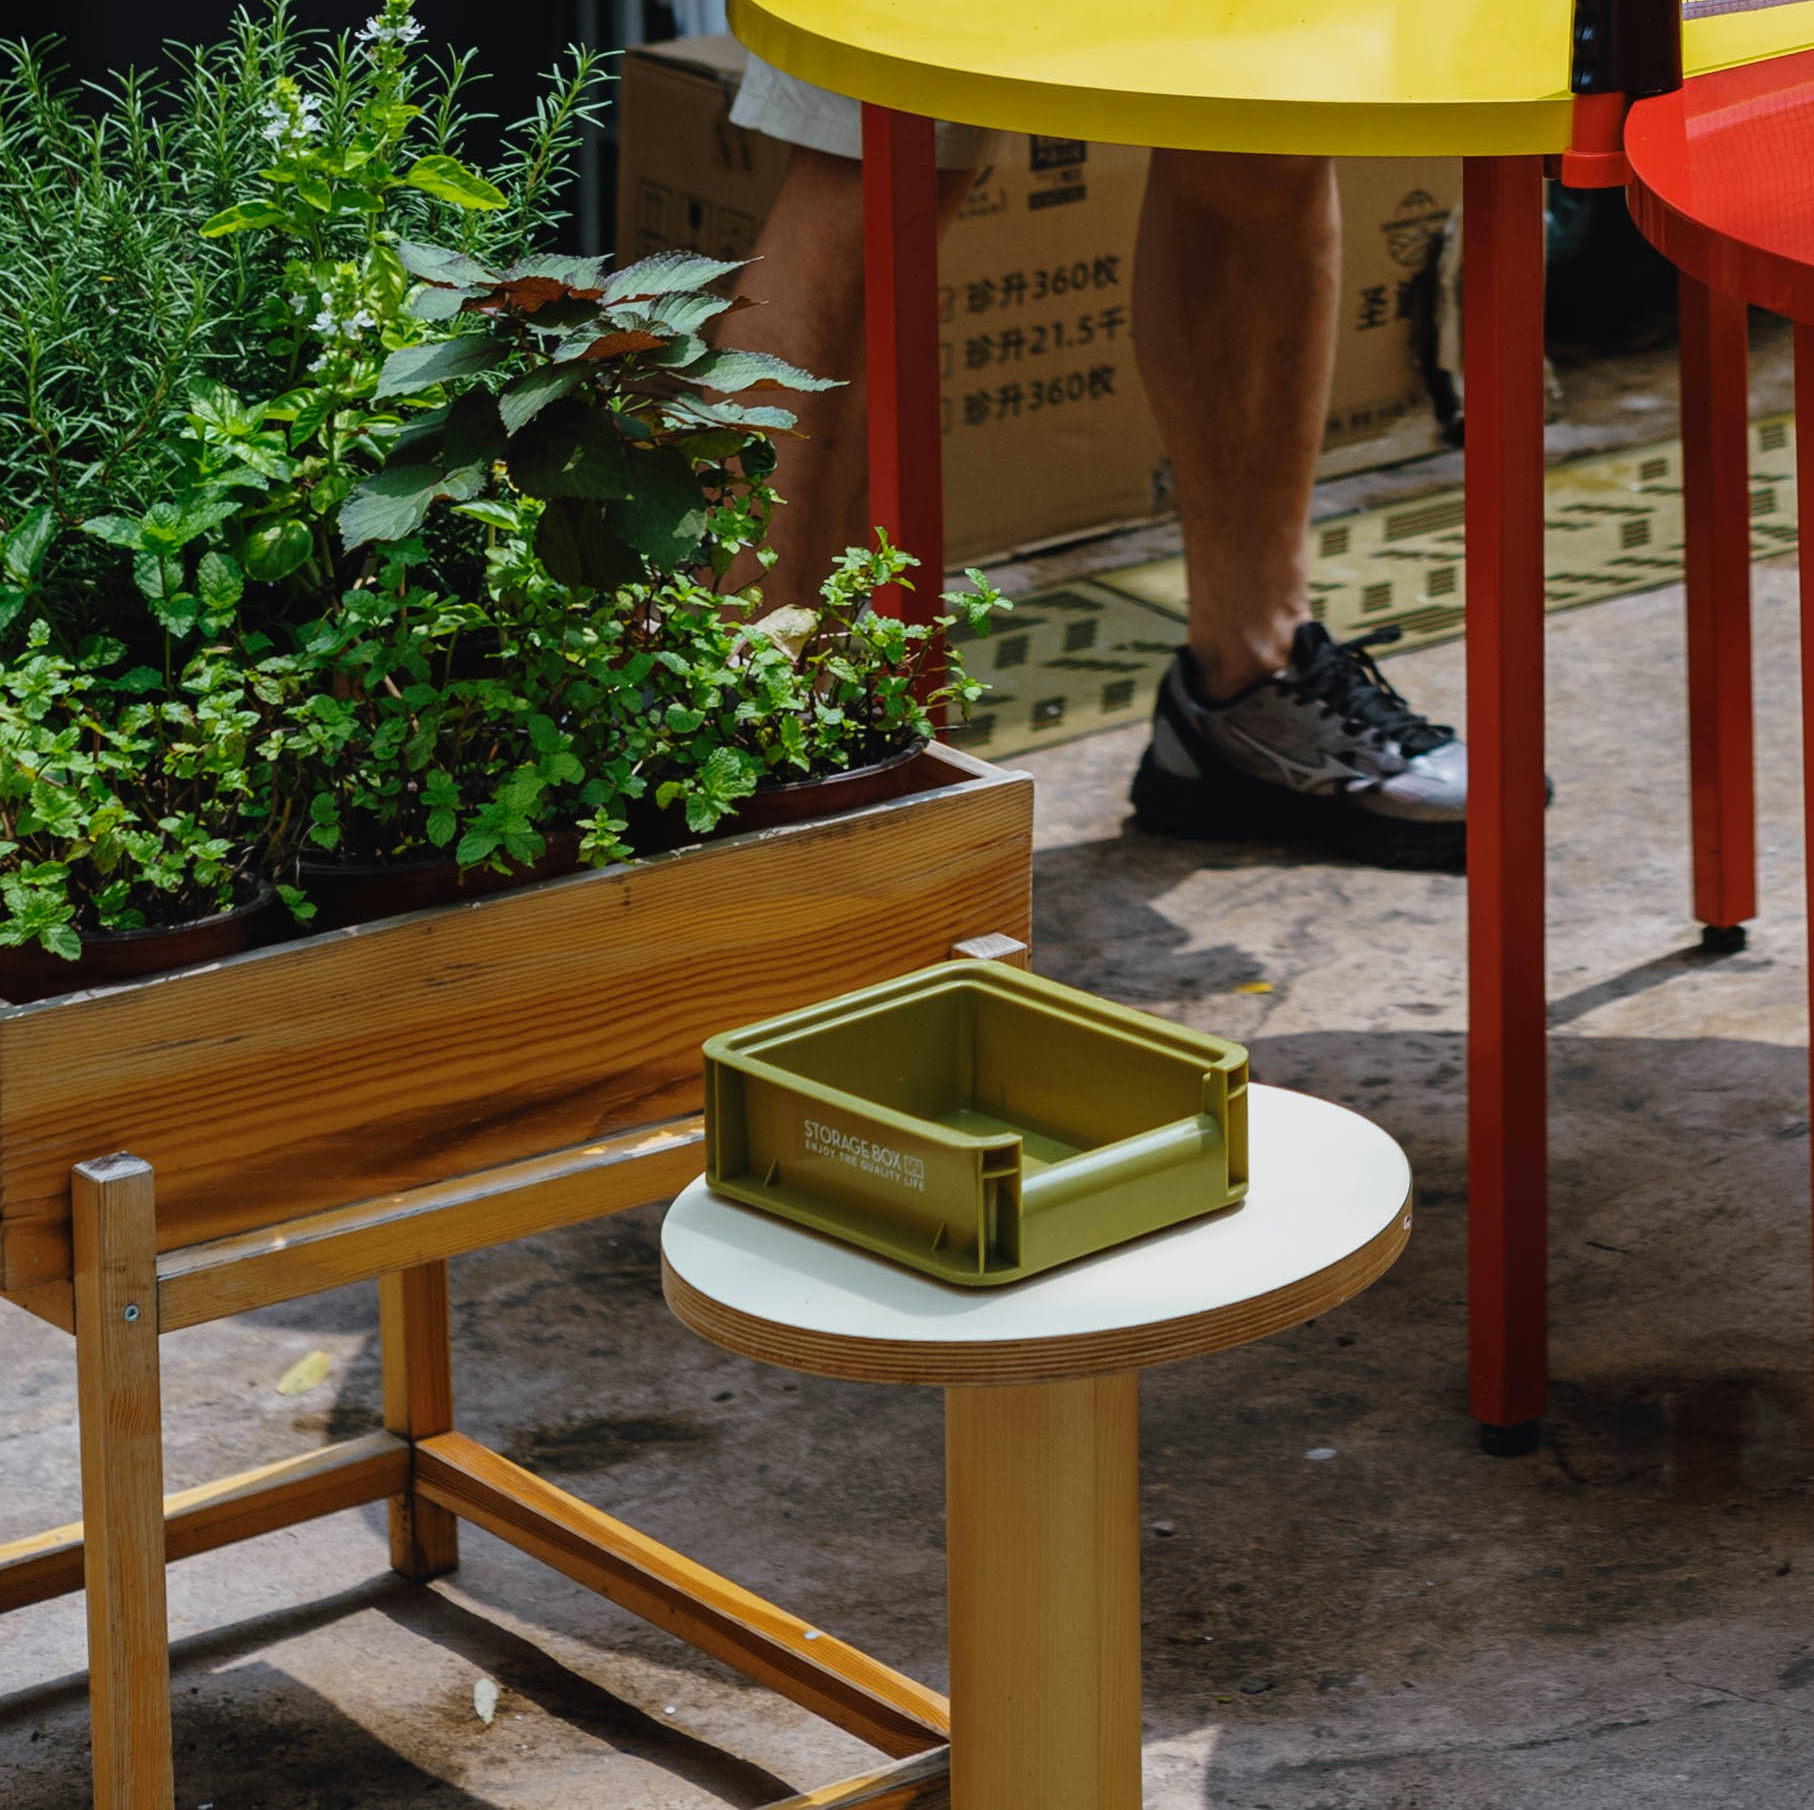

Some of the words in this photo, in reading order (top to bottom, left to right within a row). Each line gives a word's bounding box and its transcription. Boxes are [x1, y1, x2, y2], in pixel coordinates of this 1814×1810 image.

[804, 1119, 871, 1160] STORAGE
[872, 1143, 902, 1171] BOX
[804, 1139, 836, 1159] ENJOY
[839, 1152, 858, 1168] THE
[860, 1161, 902, 1182] QUALITY
[903, 1174, 925, 1192] LIFE
